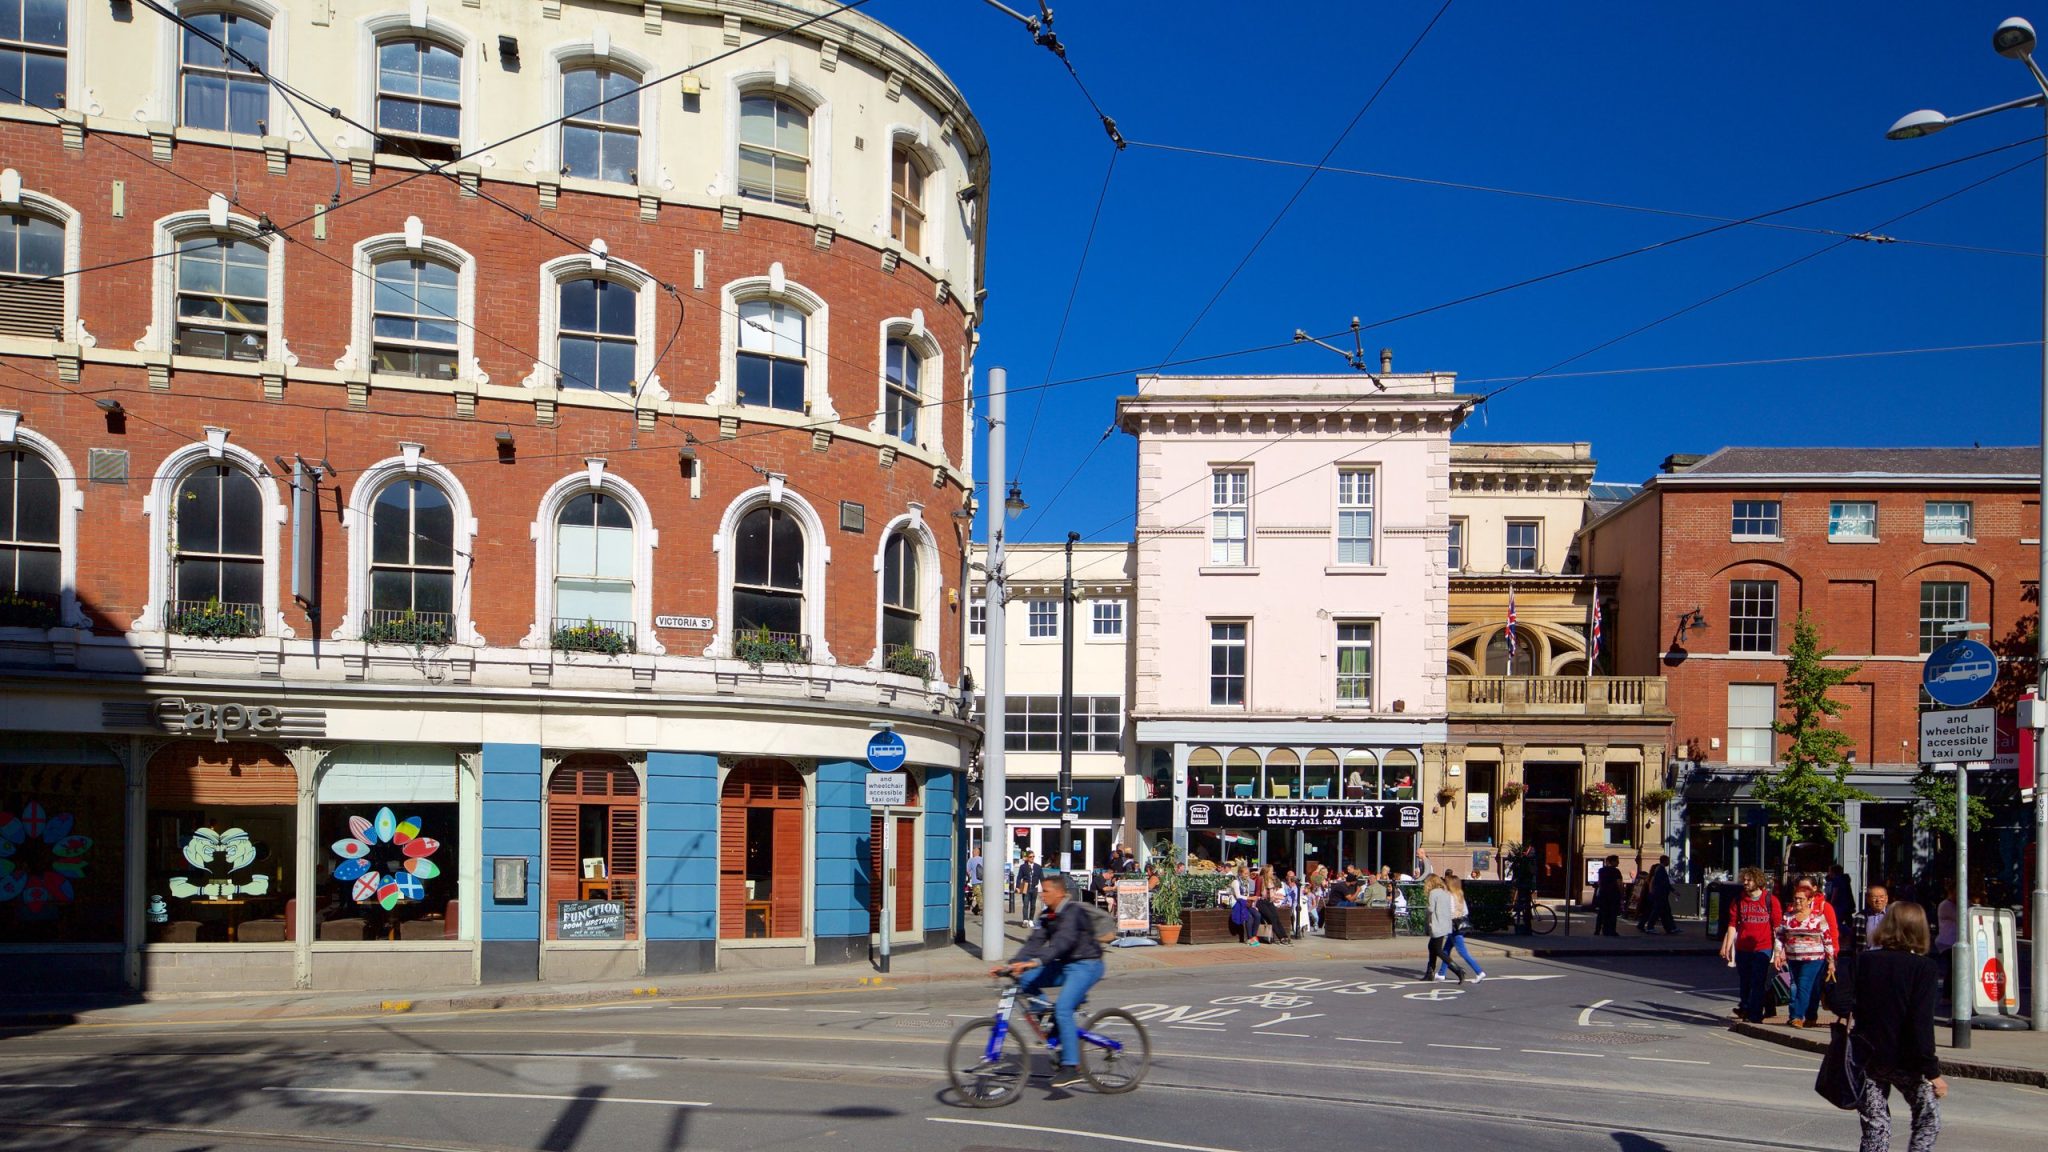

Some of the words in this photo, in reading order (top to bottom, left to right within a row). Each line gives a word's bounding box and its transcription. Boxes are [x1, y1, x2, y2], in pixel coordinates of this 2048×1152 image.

[658, 617, 698, 627] VICTORIA
[153, 697, 282, 743] Cape
[1946, 714, 1969, 724] and
[1926, 725, 1990, 736] wheelchair
[1927, 736, 1989, 747] accessible
[1931, 748, 1954, 758] taxi
[1957, 747, 1983, 758] only
[1224, 804, 1261, 817] UGLY
[1266, 804, 1319, 818] BREAD
[1323, 804, 1385, 818] BAKERY
[564, 903, 620, 922] FUNCTION
[563, 921, 583, 930] ROOM
[585, 916, 619, 927] UPSTAIRS
[1248, 976, 1406, 995] BUS
[1104, 1003, 1326, 1028] ONLY
